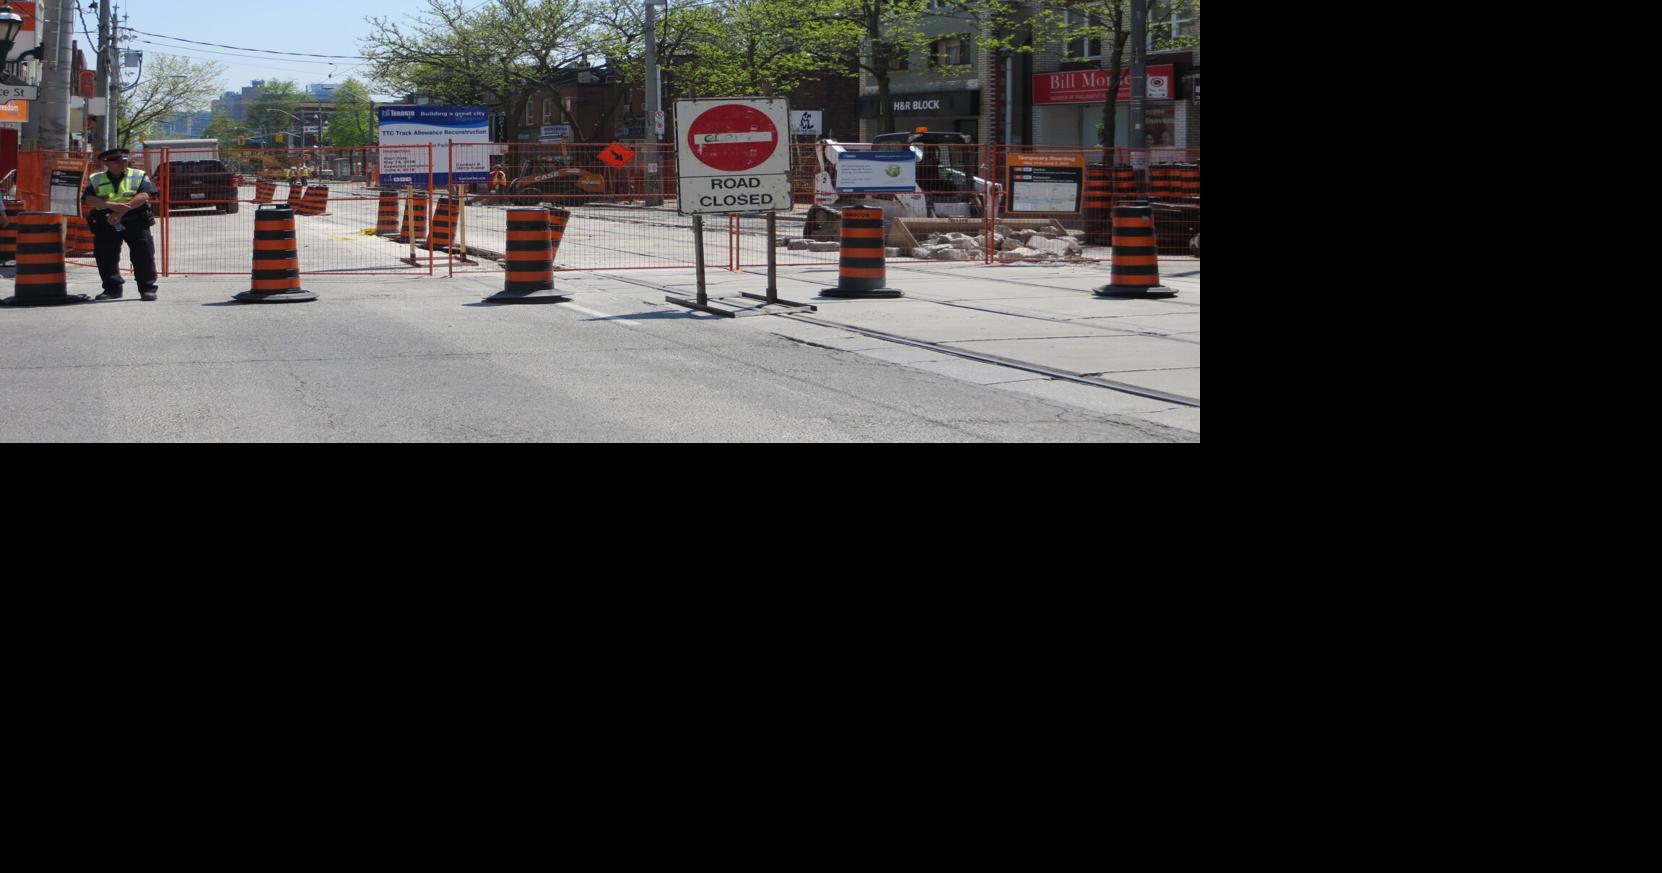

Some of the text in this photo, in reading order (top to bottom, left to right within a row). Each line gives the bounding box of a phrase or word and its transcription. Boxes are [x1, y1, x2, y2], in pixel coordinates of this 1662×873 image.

[1050, 72, 1075, 90] Bill
[14, 87, 25, 97] St
[893, 99, 940, 111] H&R BLOCK
[390, 109, 416, 117] Toronto
[420, 110, 448, 118] Building
[454, 111, 472, 119] great
[473, 110, 486, 118] city
[534, 170, 561, 181] CASE
[710, 177, 761, 190] ROAD
[699, 193, 773, 207] CLOSED
